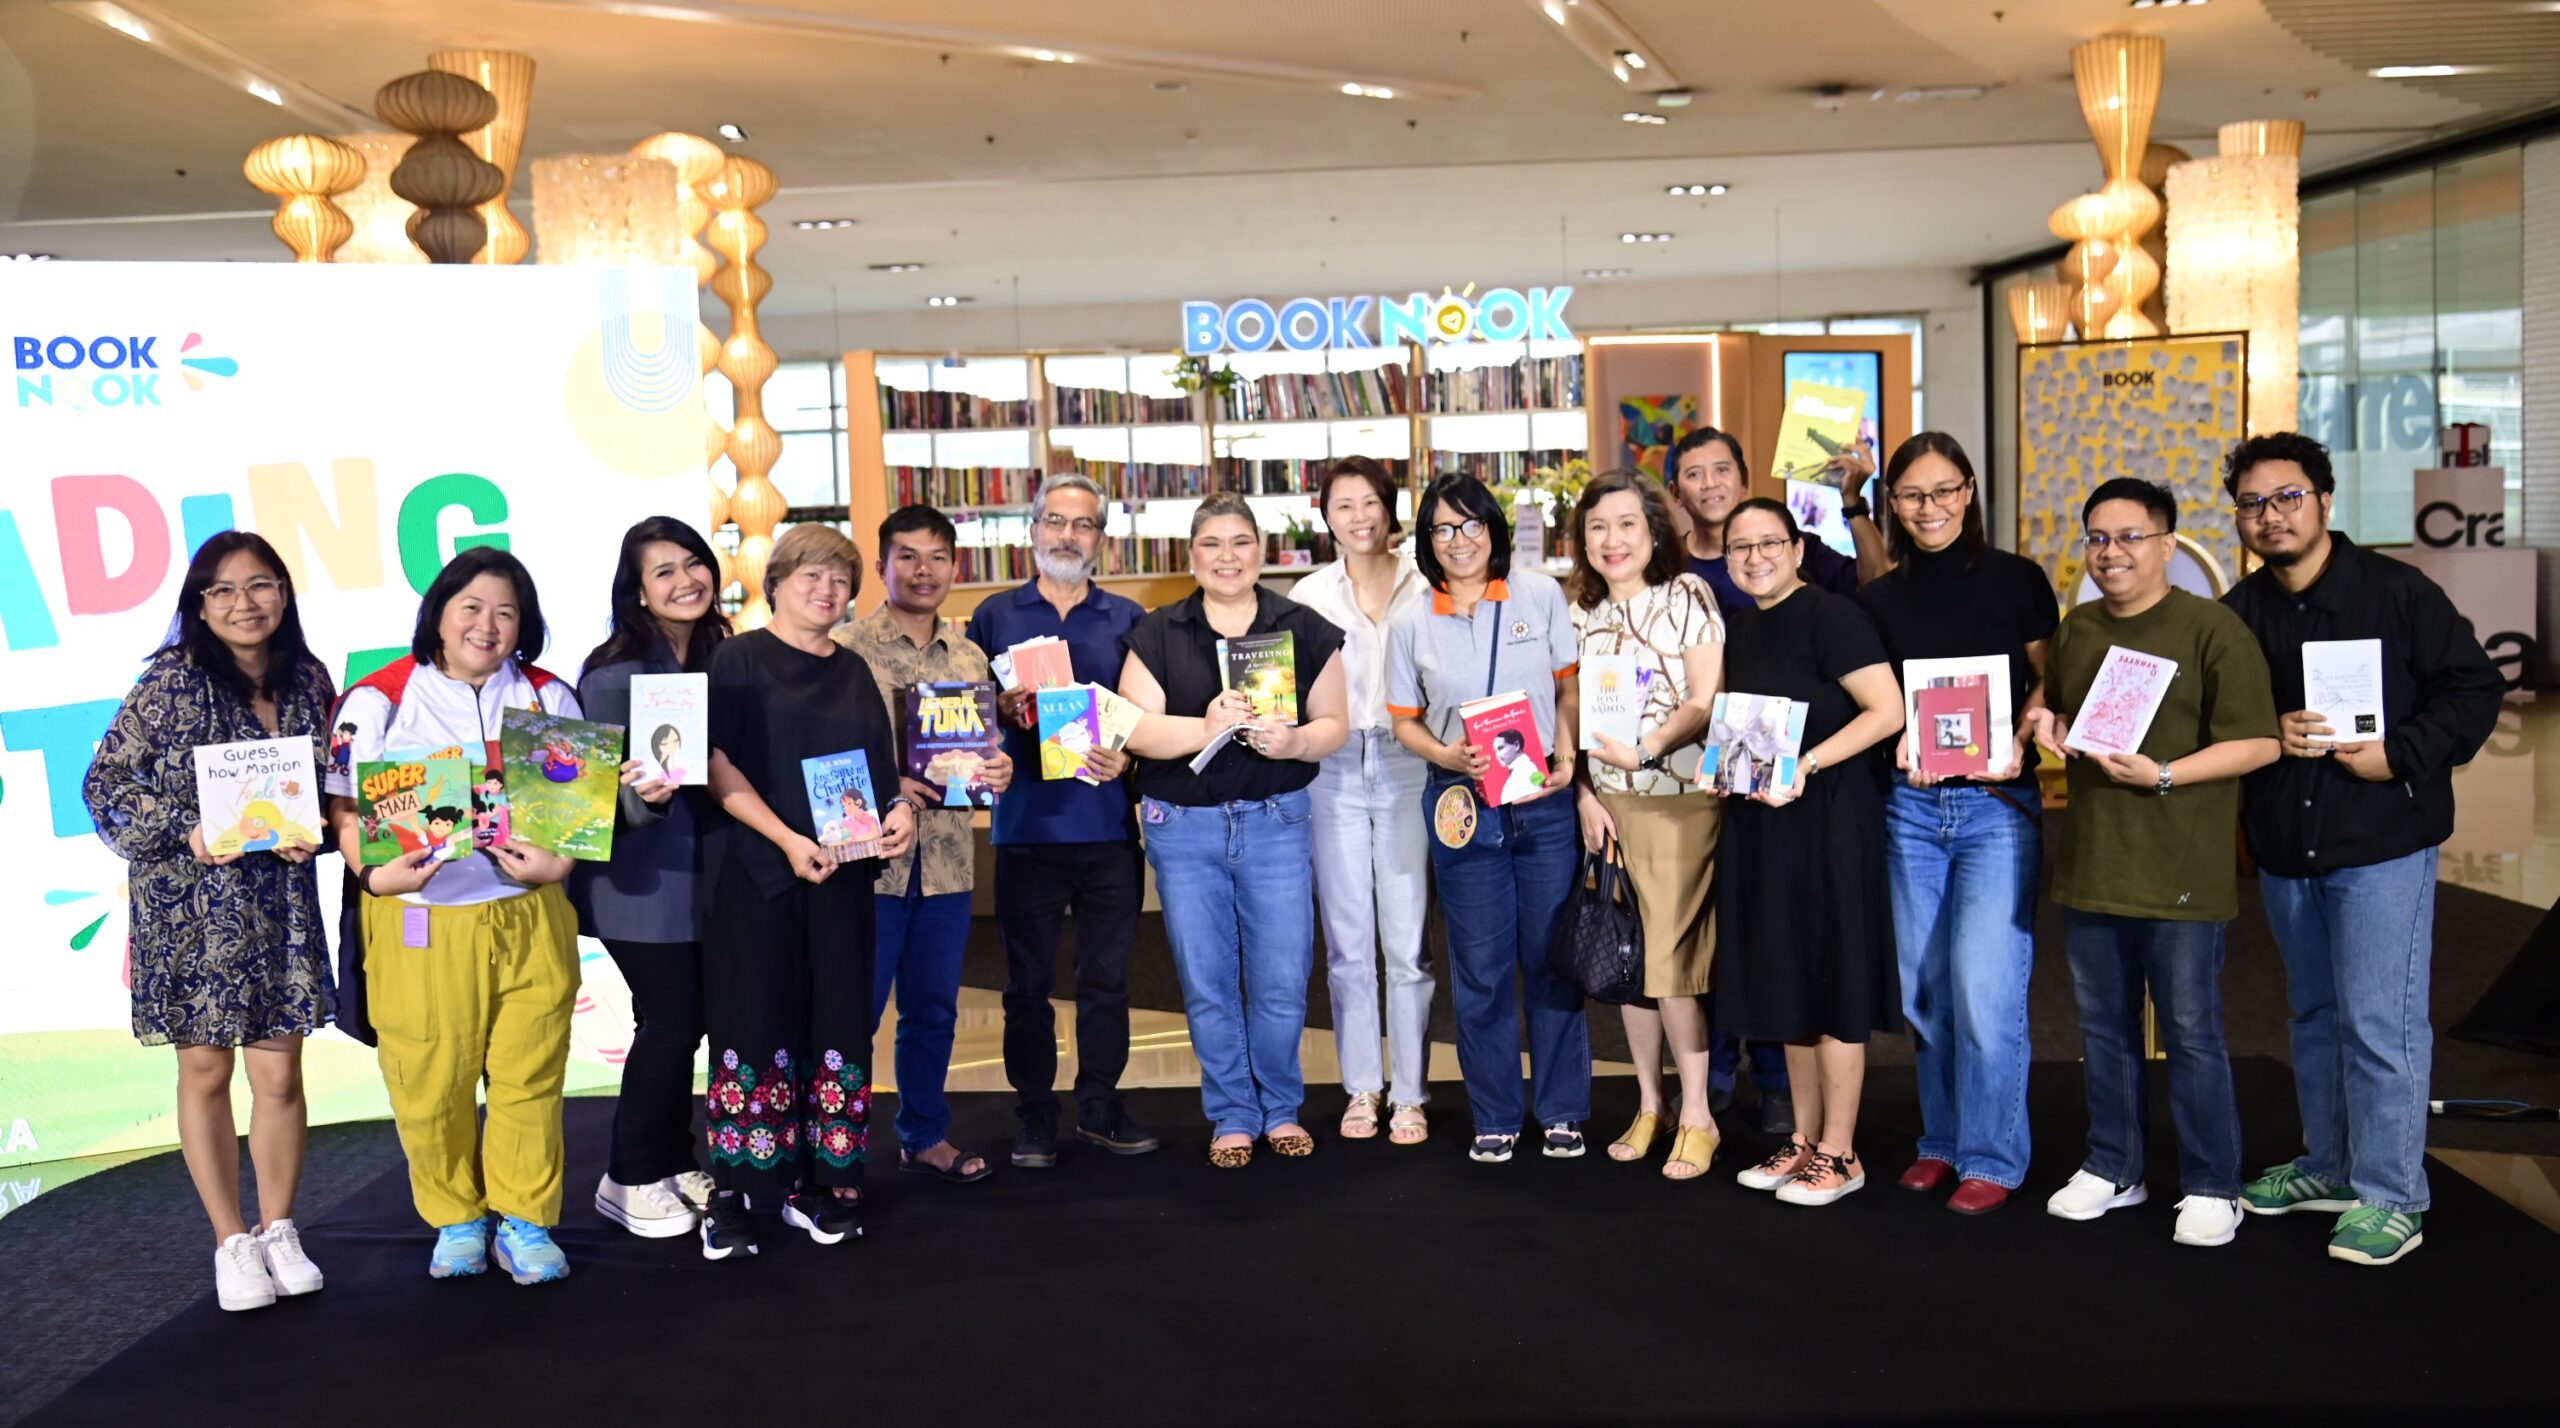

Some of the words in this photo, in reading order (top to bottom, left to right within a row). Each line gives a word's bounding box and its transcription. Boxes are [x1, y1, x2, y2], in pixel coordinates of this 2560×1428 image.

[1183, 297, 1372, 356] BOOK
[14, 335, 159, 370] BOOK
[2103, 371, 2155, 387] BOOK
[1231, 649, 1290, 661] TRAVELING
[917, 708, 986, 738] TUNA
[223, 747, 279, 761] Guess
[208, 766, 240, 779] how
[245, 760, 302, 775] Marion
[362, 763, 427, 801] SUPER
[378, 794, 418, 818] MAYA
